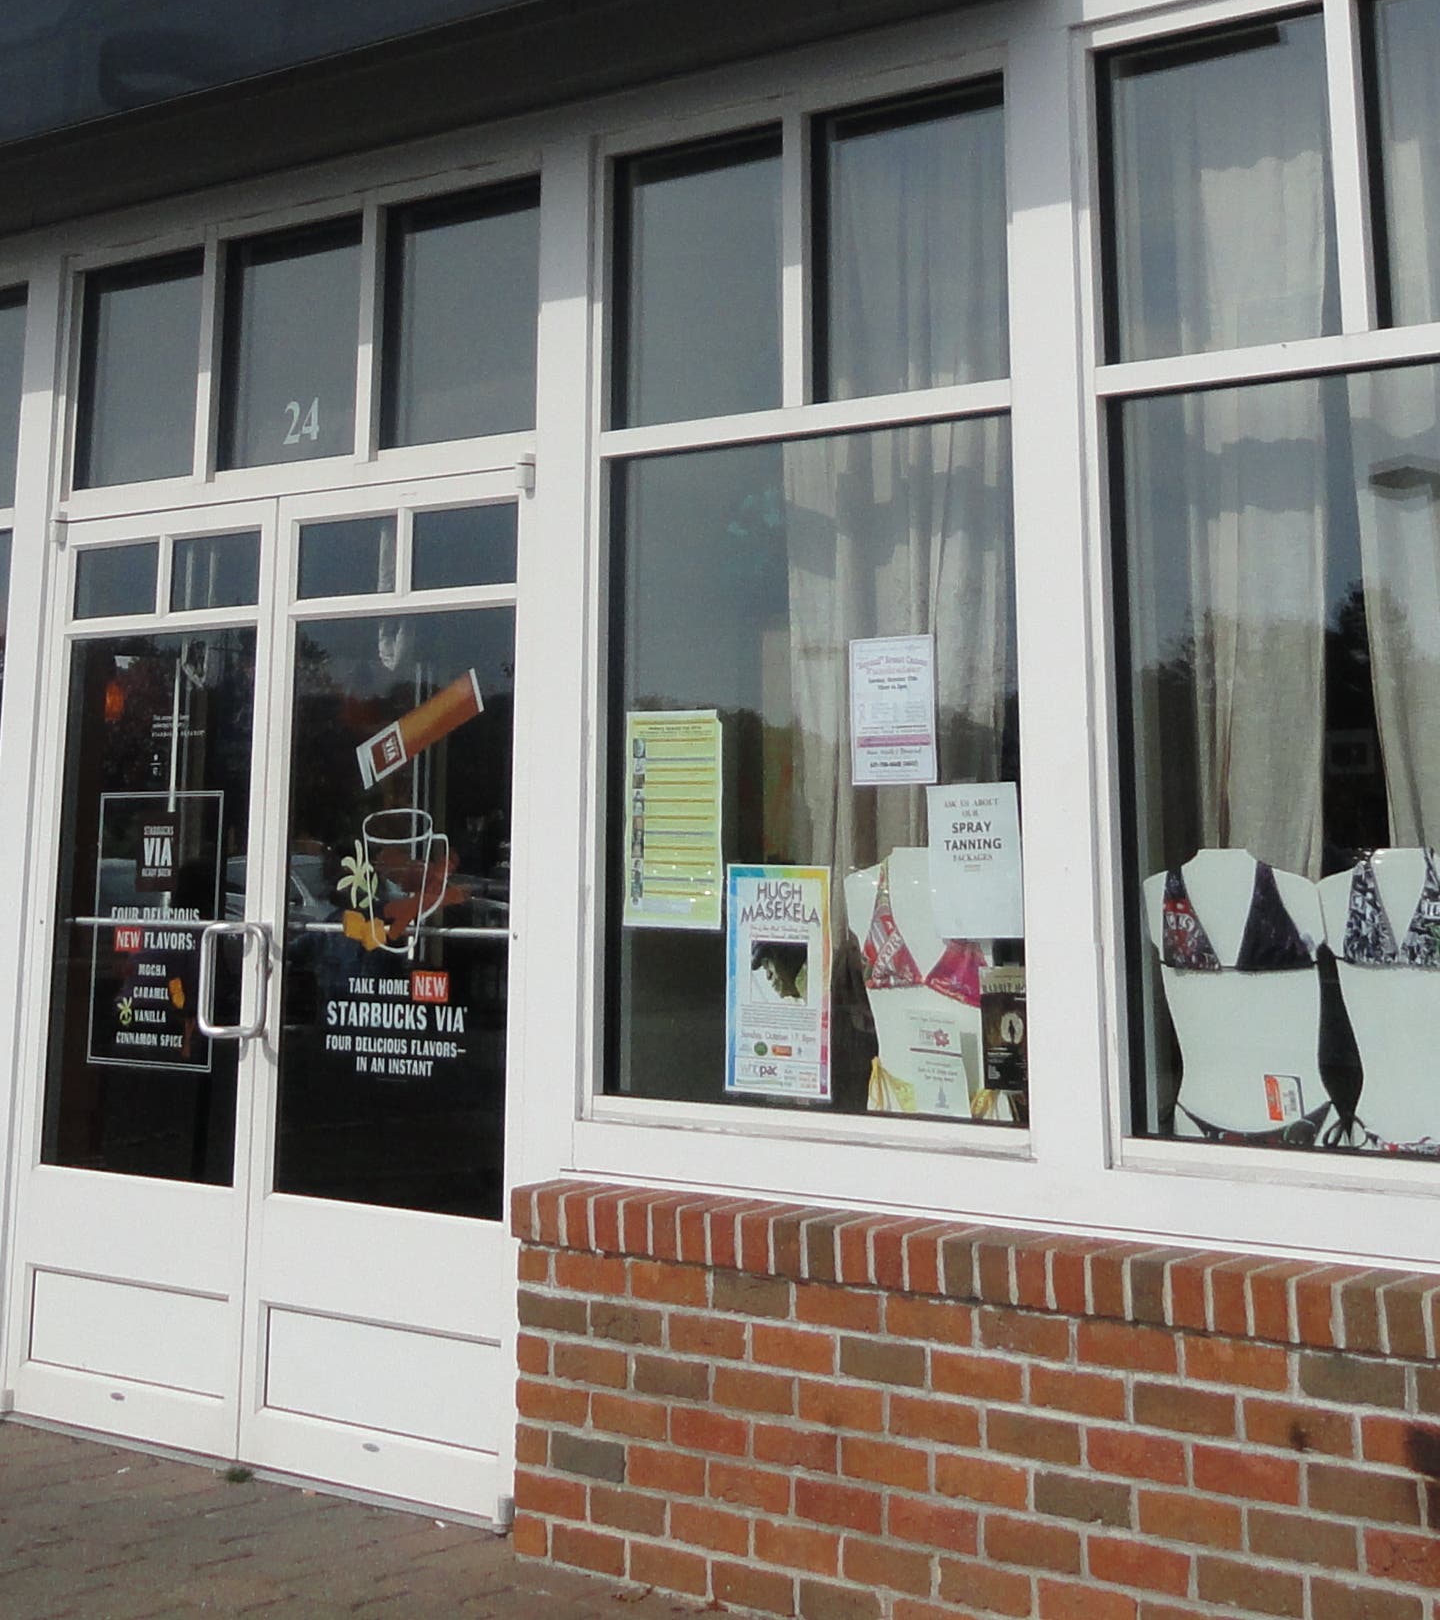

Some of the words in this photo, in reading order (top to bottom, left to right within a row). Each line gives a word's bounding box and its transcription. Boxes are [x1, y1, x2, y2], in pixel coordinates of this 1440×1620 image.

[283, 396, 320, 445] 24
[951, 821, 992, 834] SPRAY
[143, 837, 173, 867] VIA
[943, 838, 1002, 852] TANNING
[756, 881, 803, 902] HUGH
[740, 900, 821, 928] MASEKELA
[115, 930, 141, 949] NEW
[143, 931, 196, 951] FLAVORS:
[137, 963, 167, 977] MOCHA
[133, 986, 170, 1000] CARAMEL
[348, 977, 375, 995] TAKE
[378, 978, 410, 997] HOME
[413, 975, 448, 998] NEW
[133, 1009, 167, 1023] VANILLA
[326, 1000, 428, 1031] STARBUCKS
[116, 1031, 158, 1047] CINNAMON
[160, 1033, 184, 1048] SPICE
[325, 1034, 352, 1052] FOUR
[355, 1036, 408, 1055] DELICIOUS
[355, 1056, 368, 1073] IN
[370, 1057, 386, 1074] AN
[388, 1058, 435, 1078] INSTANT
